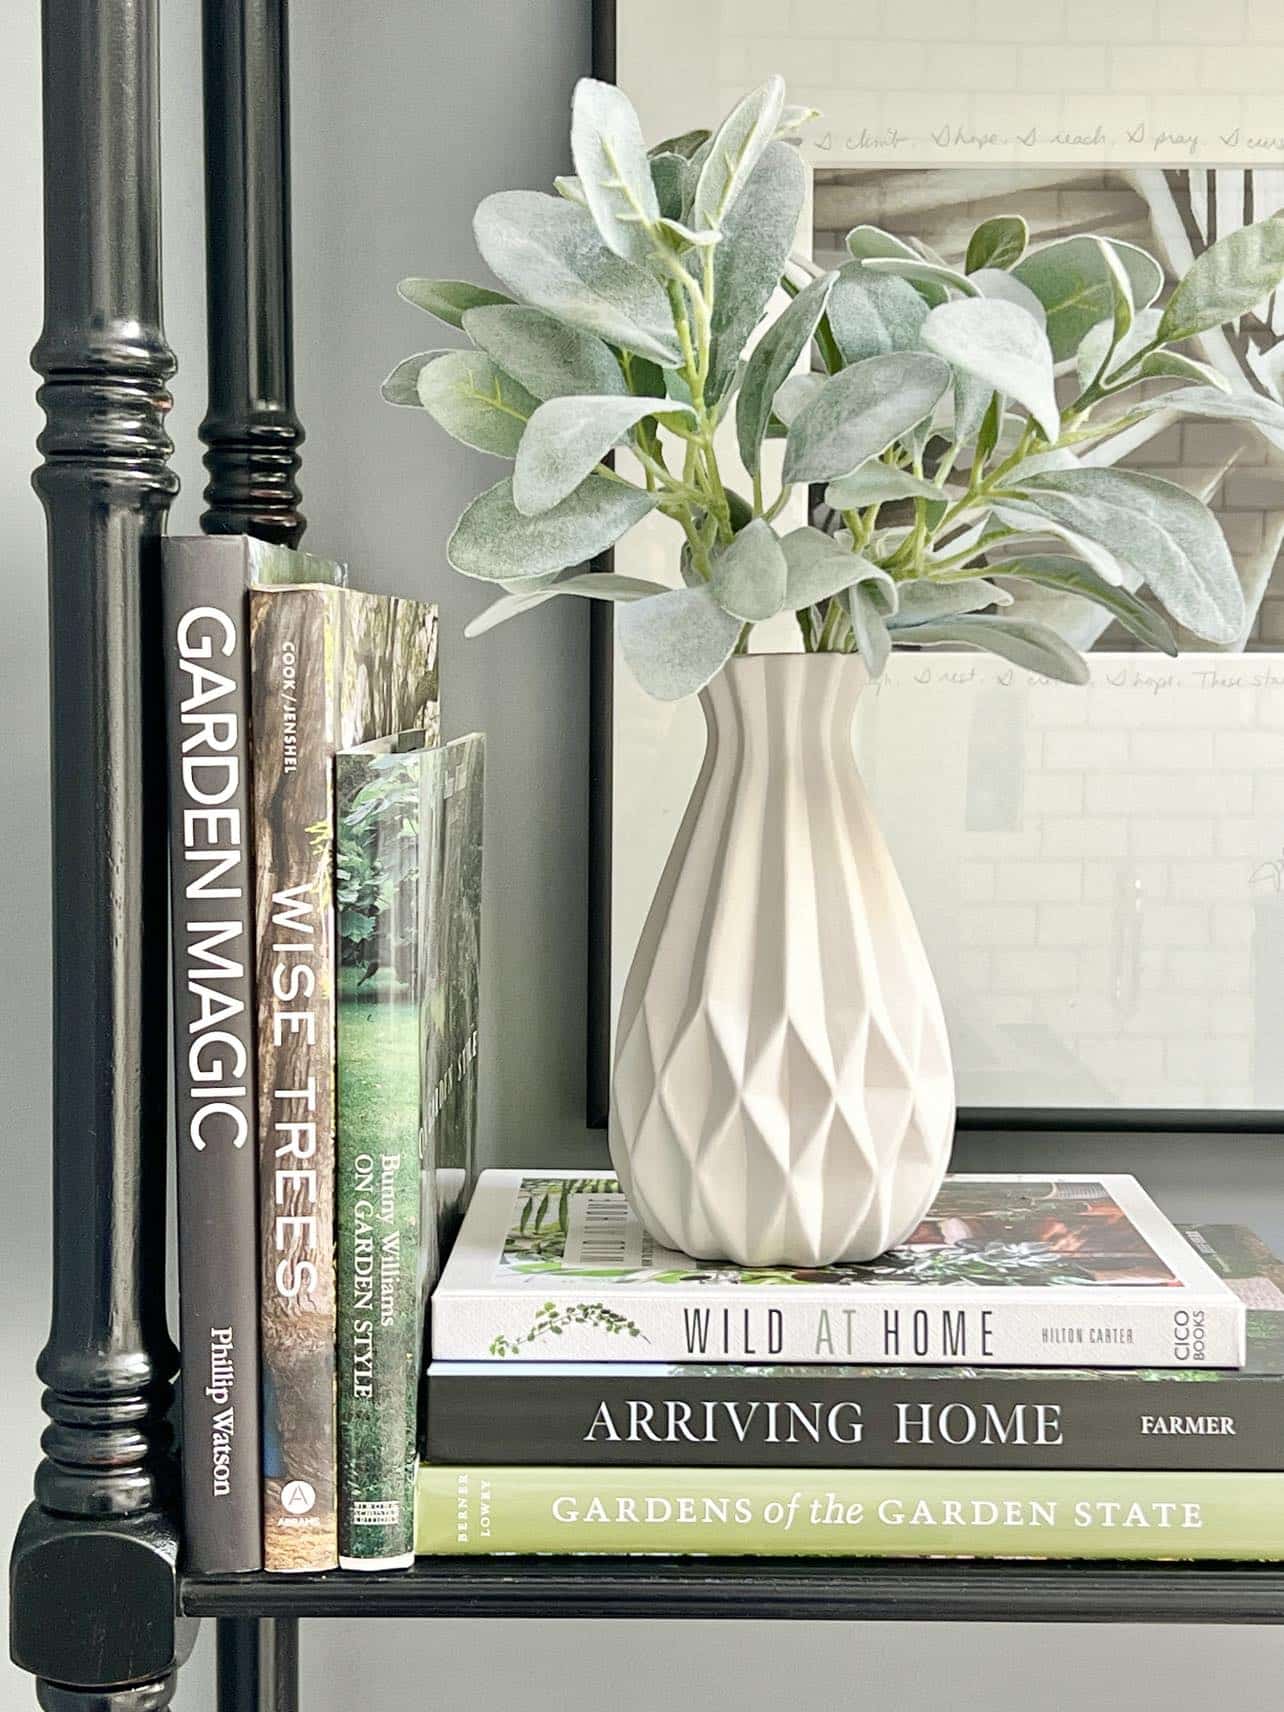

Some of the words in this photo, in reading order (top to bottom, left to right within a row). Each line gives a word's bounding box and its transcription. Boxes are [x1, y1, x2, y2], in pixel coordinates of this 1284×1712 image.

[176, 606, 242, 899] GARDEN
[271, 883, 317, 1047] WISE
[186, 921, 249, 1151] MAGIC
[274, 1077, 319, 1297] TREES
[354, 1153, 374, 1193] ON
[376, 1154, 401, 1226] Bunny
[353, 1200, 374, 1311] GARDEN
[380, 1230, 401, 1328] Williams
[204, 1327, 235, 1405] Phillip
[353, 1319, 373, 1399] STYLE
[683, 1307, 784, 1355] WILD
[815, 1308, 858, 1356] AT
[883, 1309, 995, 1357] HOME
[1041, 1327, 1084, 1344] HILTON
[1088, 1328, 1135, 1345] CARTER
[1174, 1310, 1190, 1361] CICO
[1192, 1310, 1206, 1361] BOOKS
[211, 1406, 235, 1497] Watson
[583, 1399, 864, 1444] ARRIVING
[893, 1402, 1064, 1446] HOME
[1140, 1415, 1237, 1436] FARMER
[456, 1472, 470, 1543] BERNER
[480, 1479, 492, 1538] LOWRY
[551, 1496, 754, 1524] GARDENS
[762, 1491, 803, 1531] of
[809, 1491, 864, 1525] the
[877, 1499, 1058, 1527] GARDEN
[1073, 1501, 1204, 1529] STATE
